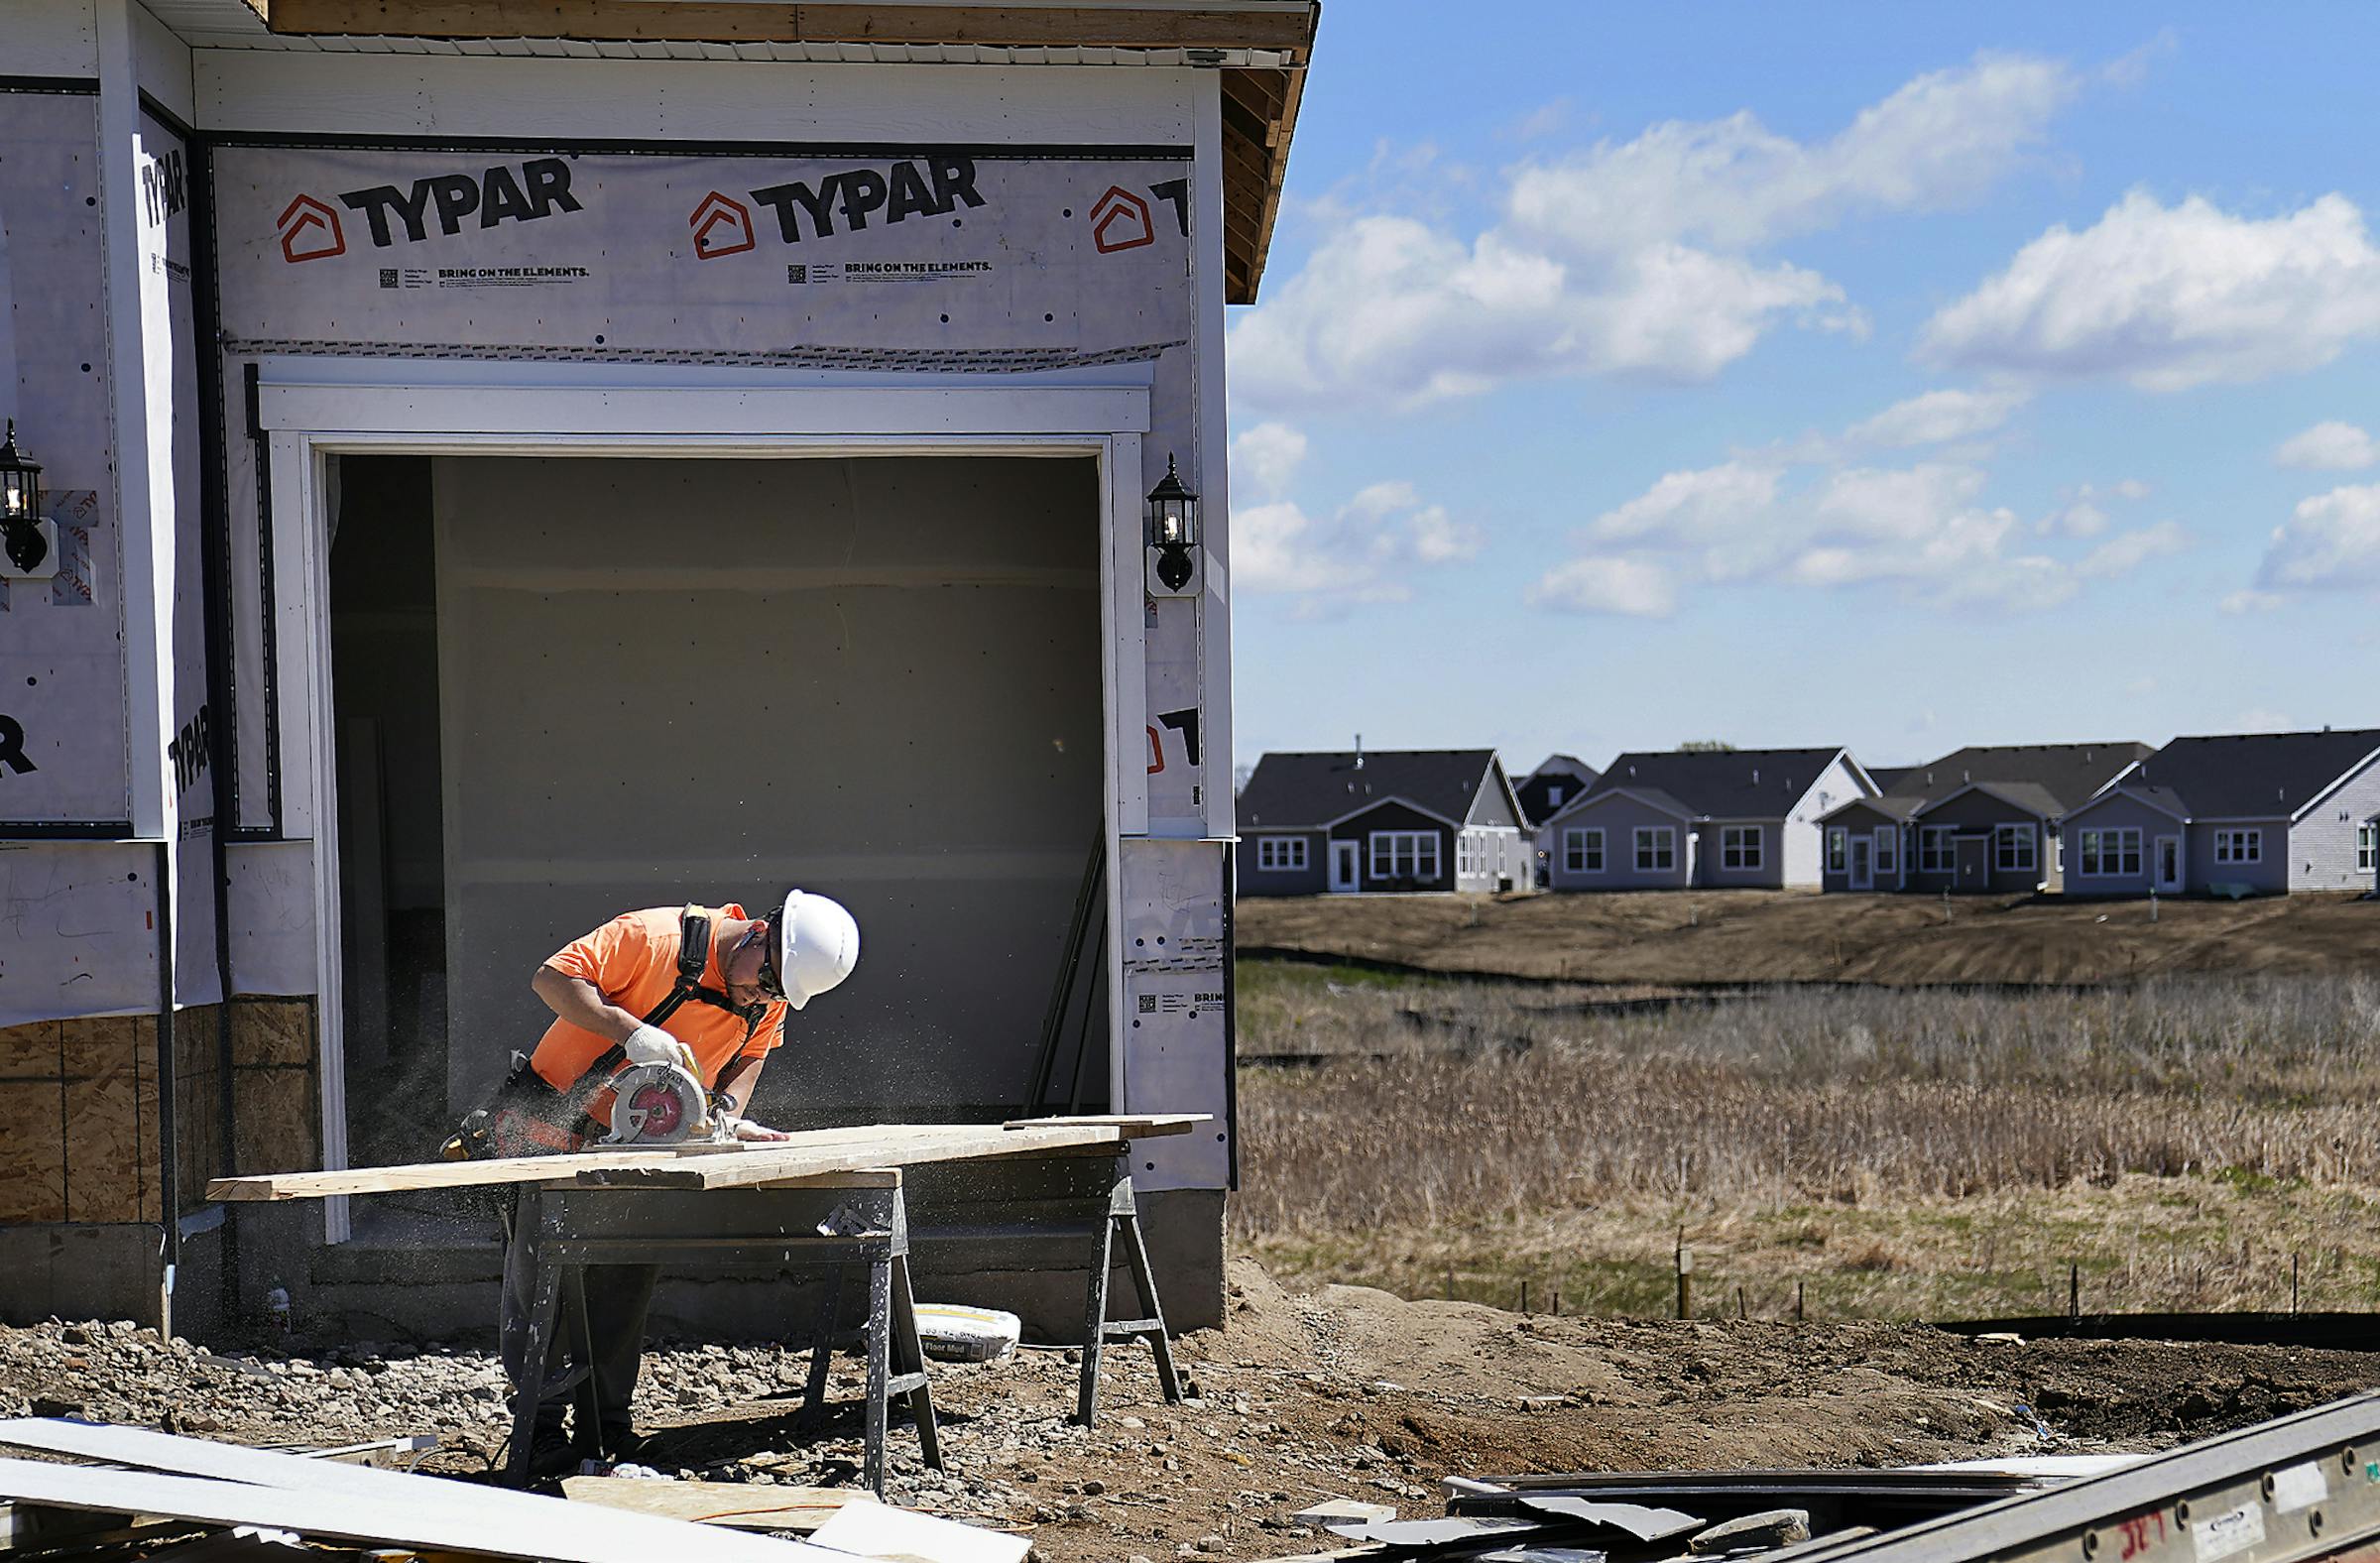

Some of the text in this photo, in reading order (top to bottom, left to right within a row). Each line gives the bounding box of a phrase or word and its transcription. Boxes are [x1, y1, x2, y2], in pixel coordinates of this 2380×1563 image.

[142, 150, 186, 228] TYPAR
[338, 158, 584, 247] TYPAR
[749, 157, 987, 245] TYPAR
[438, 268, 476, 279] BRING
[478, 268, 496, 278] ON
[498, 267, 521, 278] THE
[523, 266, 590, 278] ELEMENTS.
[845, 261, 992, 273] BRING ON THE ELEMENTS.
[1194, 993, 1225, 1003] BRIN
[925, 1342, 946, 1352] Floor
